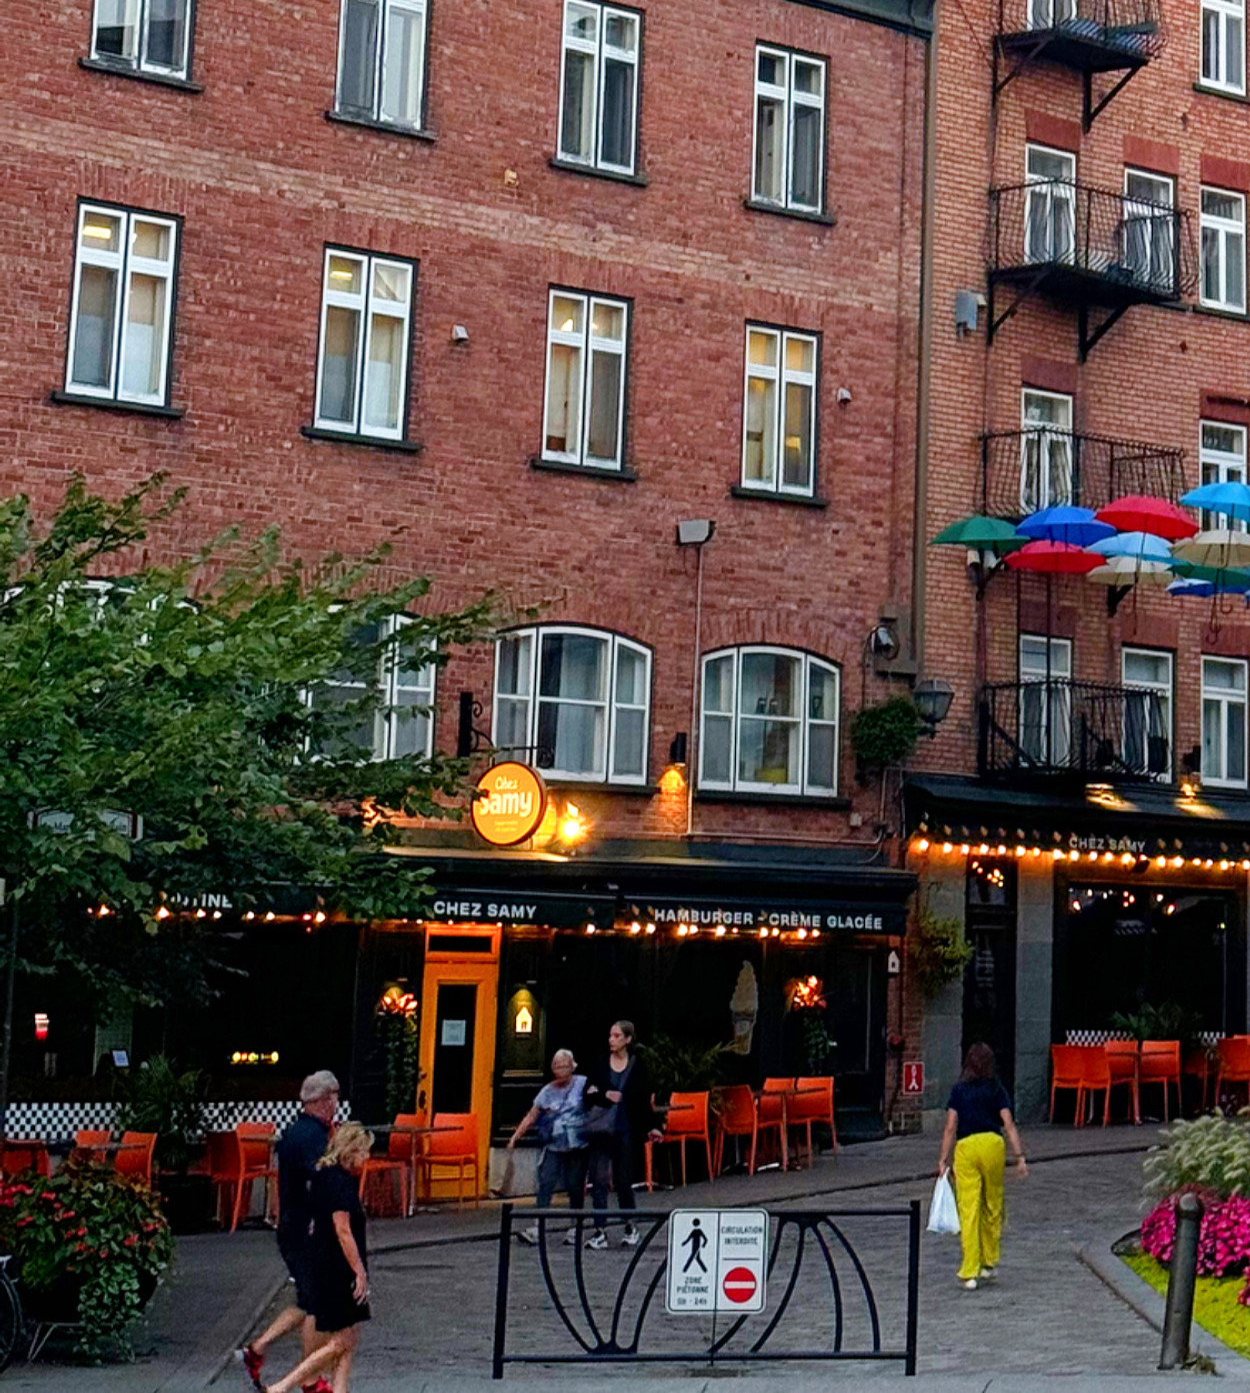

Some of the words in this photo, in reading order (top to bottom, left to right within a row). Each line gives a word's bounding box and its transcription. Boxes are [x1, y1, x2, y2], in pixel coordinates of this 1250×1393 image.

[479, 792, 532, 817] Samy
[1069, 836, 1105, 850] CHEZ
[1109, 838, 1145, 853] SAMY
[433, 900, 482, 917] CHEZ
[487, 903, 537, 919] SAMY
[654, 908, 754, 925] HAMBURGER
[769, 910, 821, 928] CRÈME
[827, 913, 883, 930] GLACÉE
[721, 1226, 762, 1234] CIRCULATION
[725, 1237, 758, 1245] INTERDITE
[684, 1276, 702, 1285] ZONE
